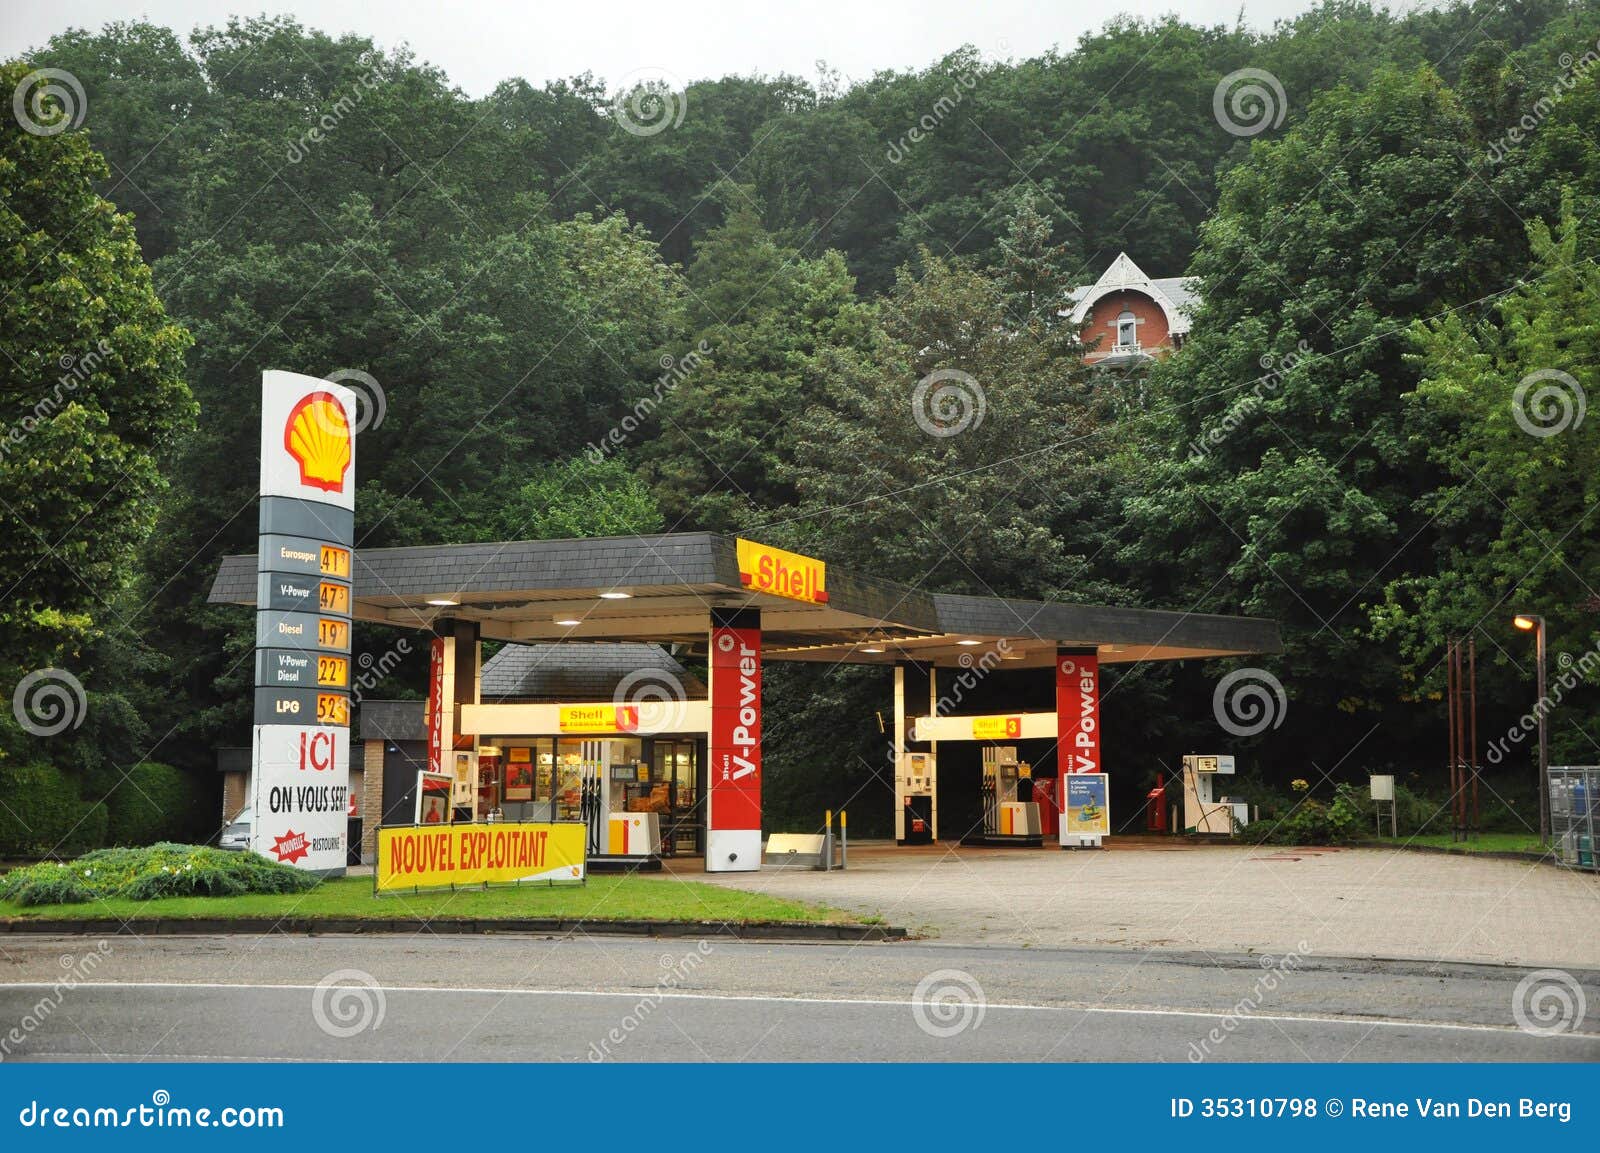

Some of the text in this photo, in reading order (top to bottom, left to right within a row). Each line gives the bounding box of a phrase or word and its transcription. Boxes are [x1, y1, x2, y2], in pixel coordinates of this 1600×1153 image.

[281, 547, 317, 562] Eurosuper
[758, 554, 817, 598] Shell
[281, 585, 310, 598] V-Power
[279, 623, 303, 634] Diesel
[279, 655, 308, 667] V-Power
[277, 670, 299, 681] Diesel
[276, 700, 300, 713] LPG
[733, 643, 757, 781] V-Power
[570, 709, 629, 726] Shell 1
[1076, 667, 1096, 775] V-Power
[1008, 719, 1017, 734] 3
[299, 732, 336, 771] ICI
[269, 786, 347, 813] ON VOUS SERT
[312, 836, 340, 852] RISTOURNE
[391, 834, 455, 875] NOUVEL
[460, 831, 547, 871] EXPLOITANT
